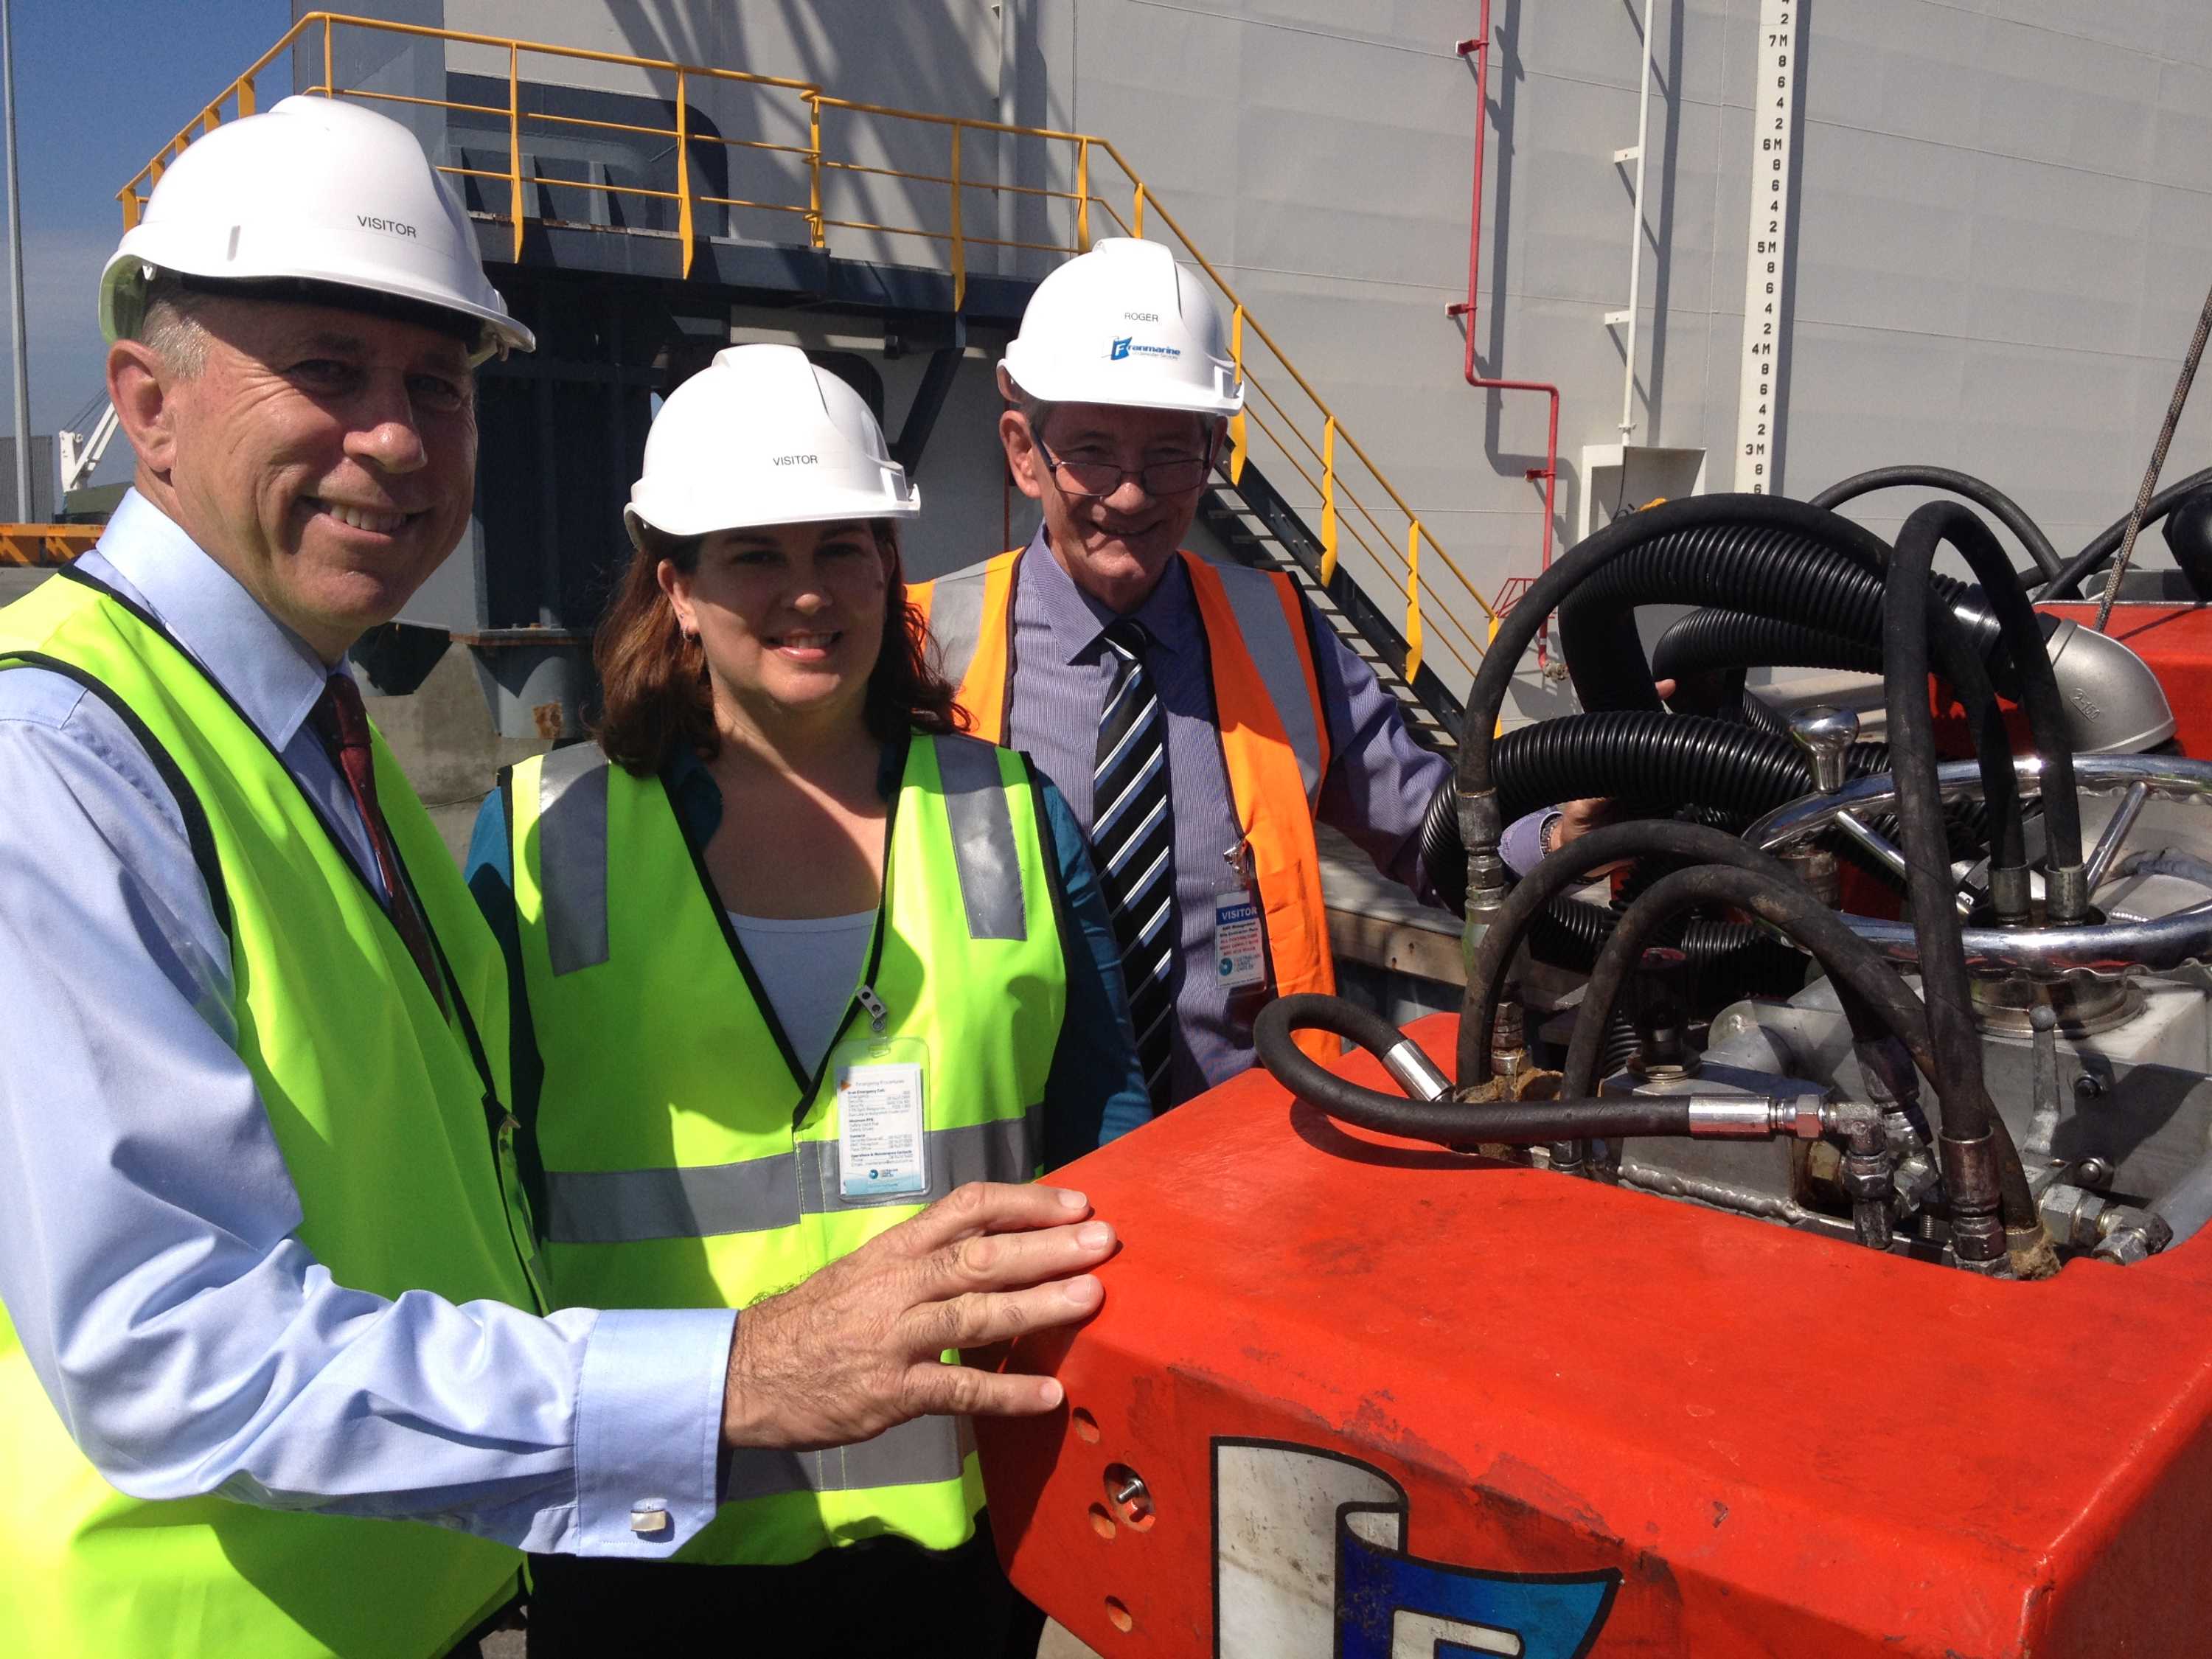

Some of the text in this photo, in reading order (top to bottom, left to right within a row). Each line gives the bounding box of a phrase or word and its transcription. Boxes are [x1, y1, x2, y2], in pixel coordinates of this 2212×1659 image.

[1780, 13, 1789, 25] 2
[1778, 55, 1787, 68] 8
[1777, 75, 1786, 88] 6
[1775, 97, 1784, 109] 4
[1774, 117, 1784, 130] 2
[1773, 159, 1781, 171] 8
[1771, 179, 1780, 192] 6
[1770, 200, 1778, 212] 4
[357, 215, 417, 238] VISITOR
[1769, 220, 1778, 233] 2
[1766, 261, 1775, 274] 8
[1765, 282, 1774, 295] 6
[1764, 302, 1773, 315] 4
[1124, 312, 1159, 322] ROGER
[1763, 322, 1772, 335] 2
[1761, 363, 1770, 375] 8
[1759, 383, 1768, 396] 6
[1759, 403, 1767, 415] 4
[1757, 423, 1766, 436] 2
[772, 454, 818, 466] VISITOR
[1754, 463, 1763, 476] 8
[1753, 483, 1762, 494] 6
[1222, 908, 1257, 920] VISITOR
